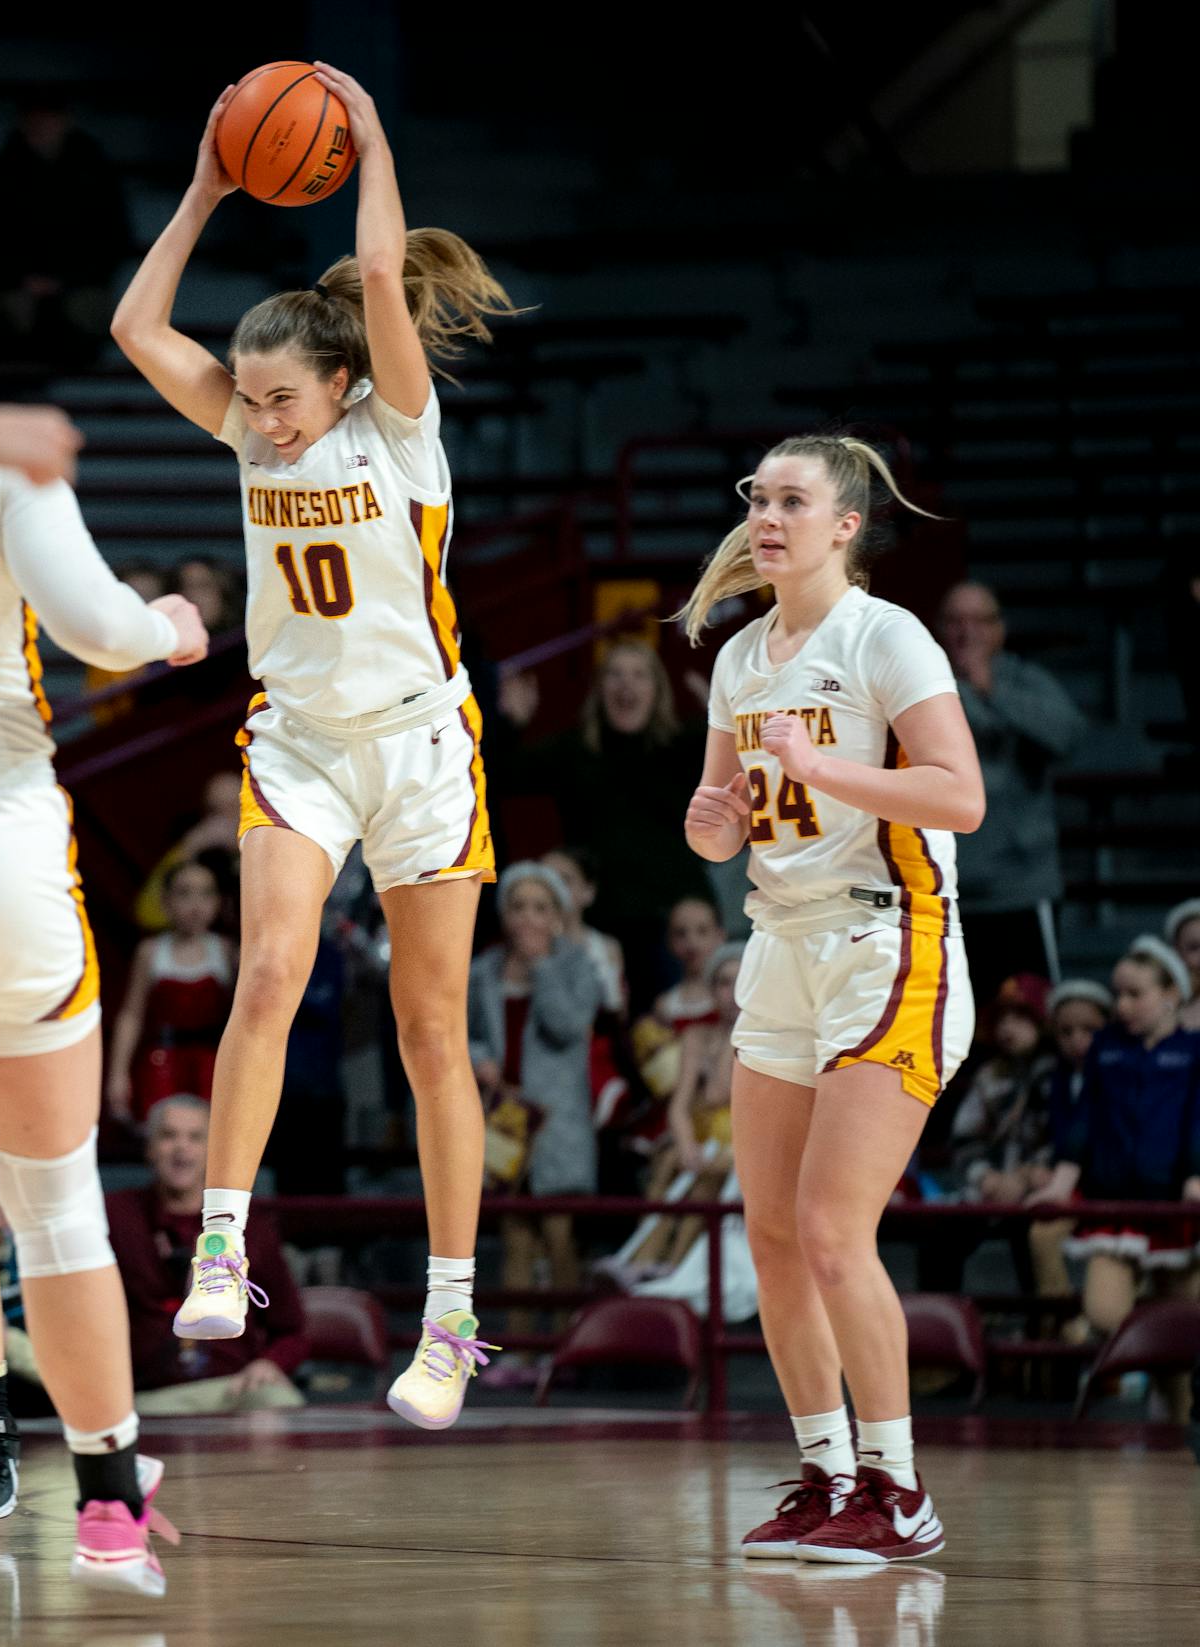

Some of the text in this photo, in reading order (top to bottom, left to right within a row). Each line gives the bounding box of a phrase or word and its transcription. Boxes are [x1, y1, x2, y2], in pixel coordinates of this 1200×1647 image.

[301, 125, 349, 196] ELITE
[274, 541, 355, 621] 10
[746, 764, 824, 846] 24
